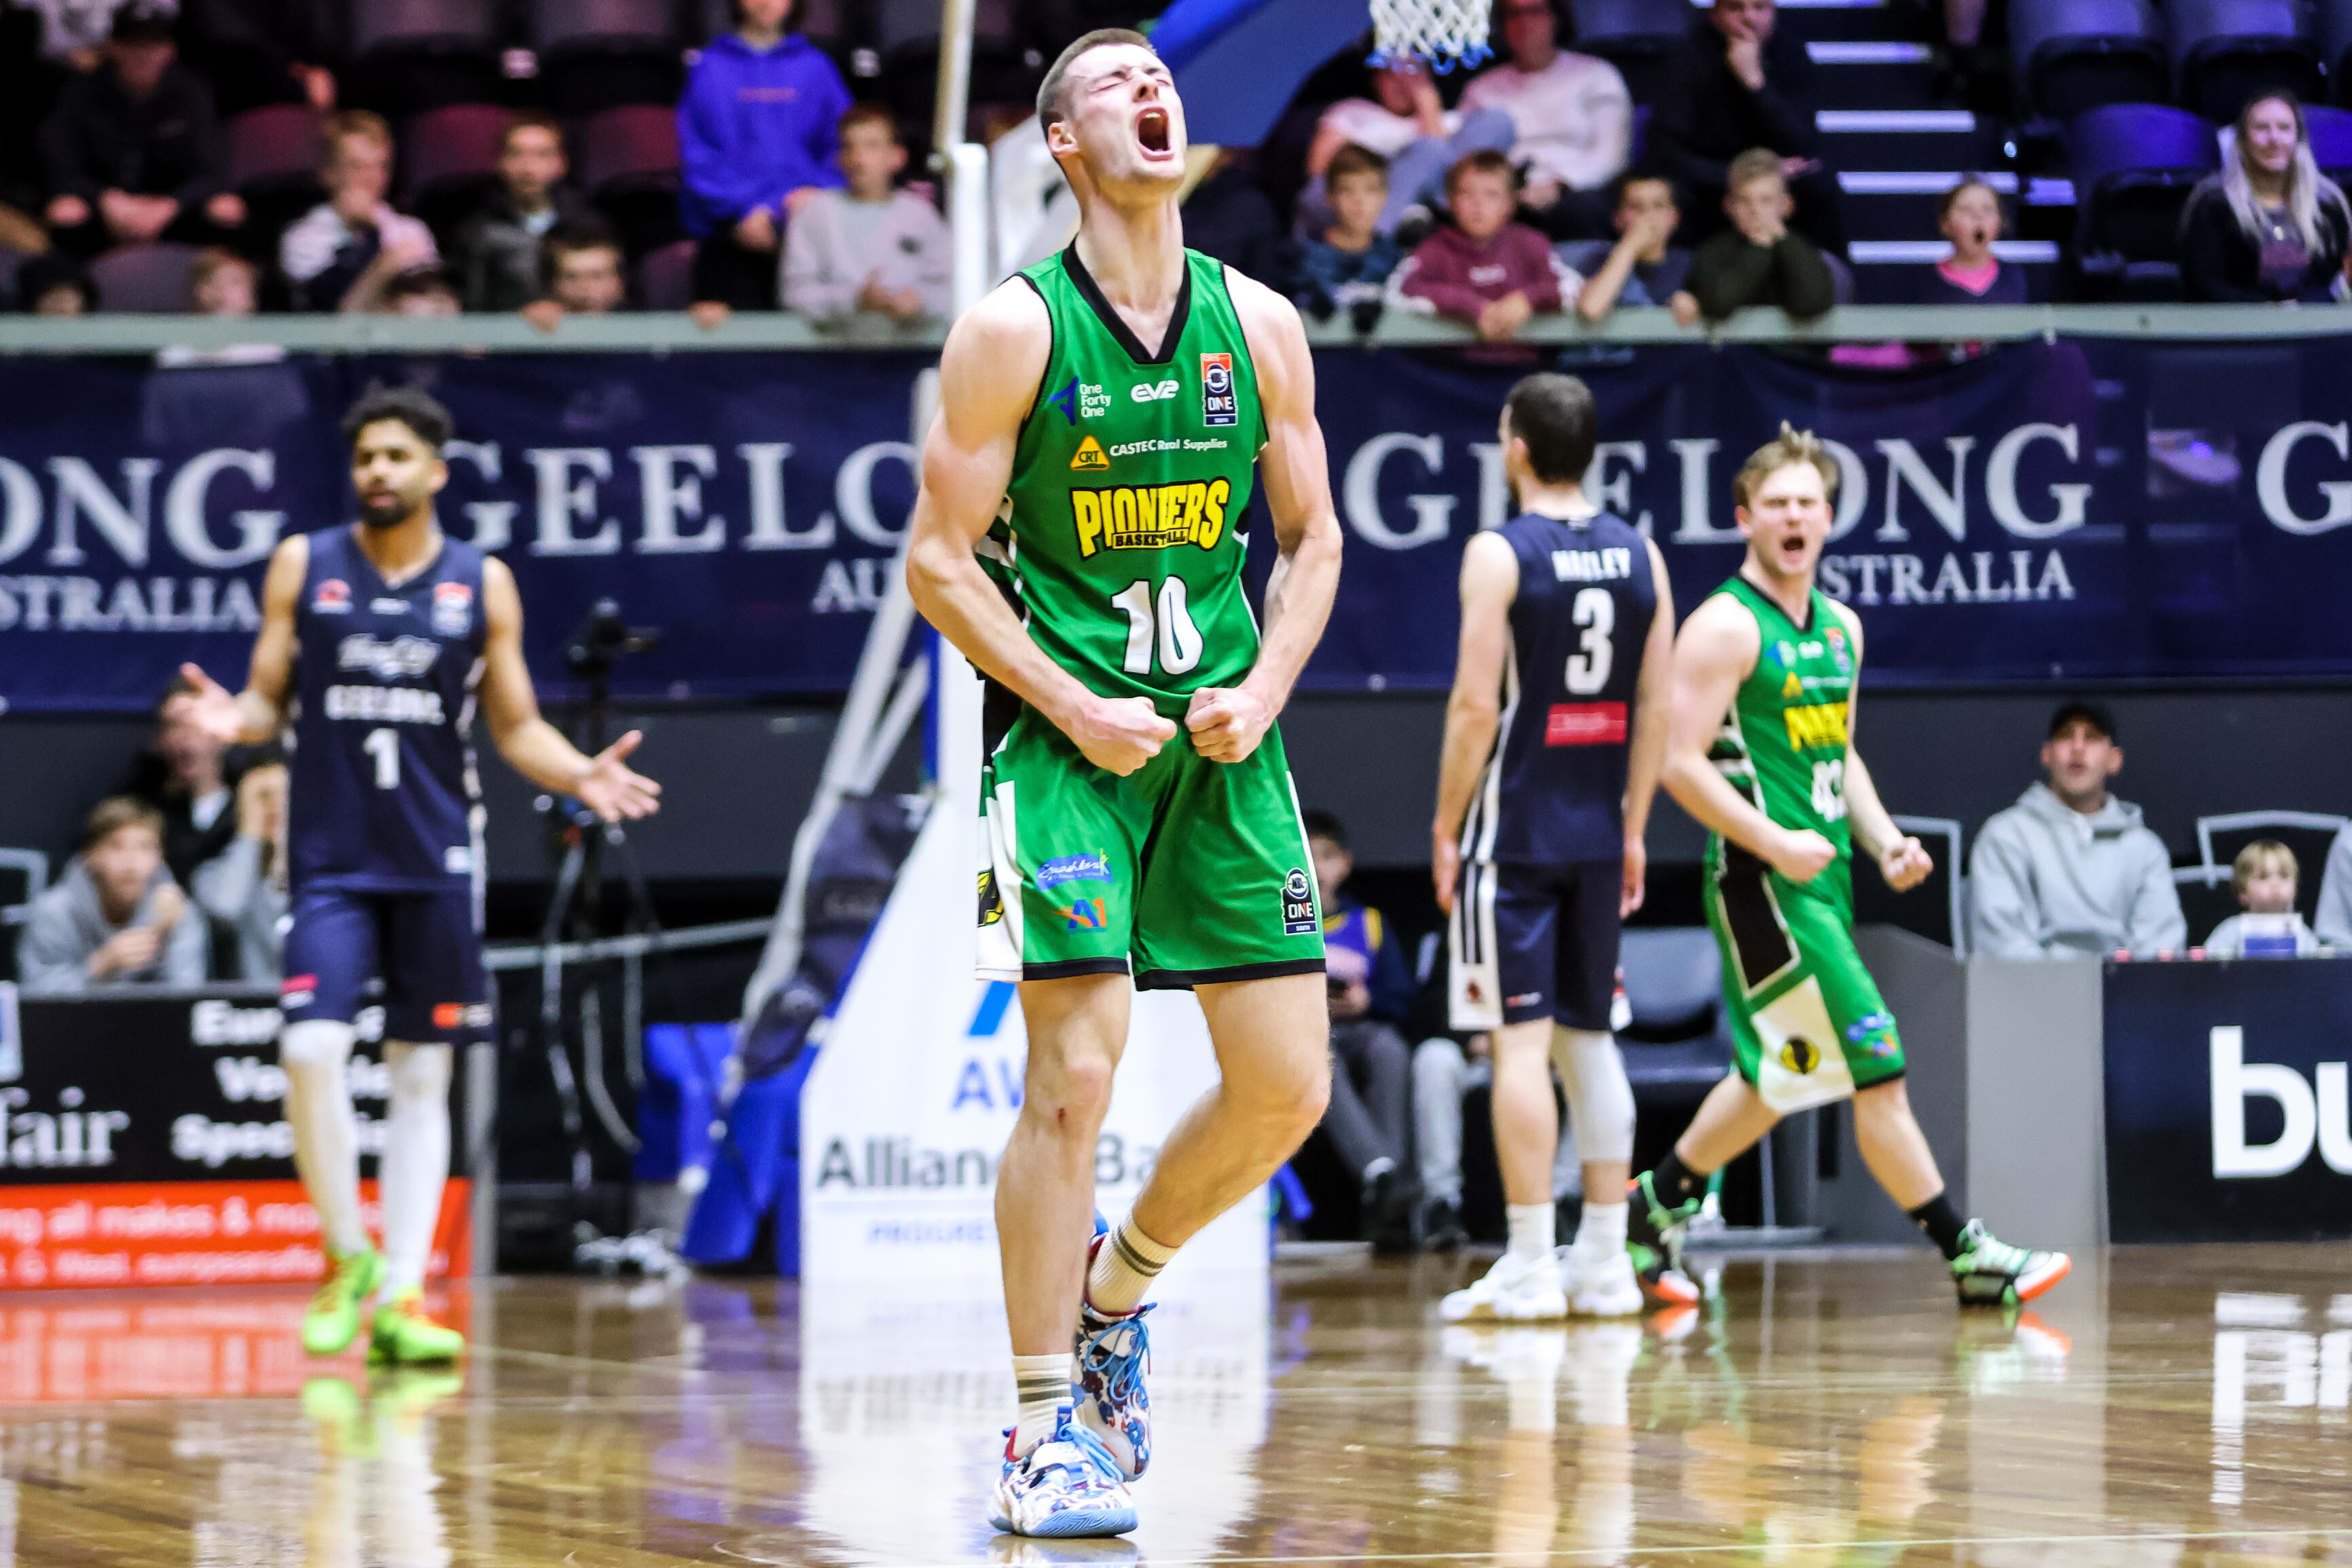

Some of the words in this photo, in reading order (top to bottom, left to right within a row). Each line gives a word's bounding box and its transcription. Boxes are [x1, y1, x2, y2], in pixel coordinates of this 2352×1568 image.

[1080, 384, 1103, 395] One
[1081, 395, 1111, 407] Forty
[1208, 397, 1233, 411] ONE
[1081, 406, 1105, 418] One
[1109, 439, 1157, 457] CASTEC
[1182, 438, 1228, 452] Supplies
[1079, 450, 1100, 463] CRT
[1111, 575, 1204, 675] 10
[1565, 587, 1615, 695] 3
[363, 727, 401, 790] 1
[1288, 902, 1314, 918] ONE
[817, 1133, 998, 1188] Allian
